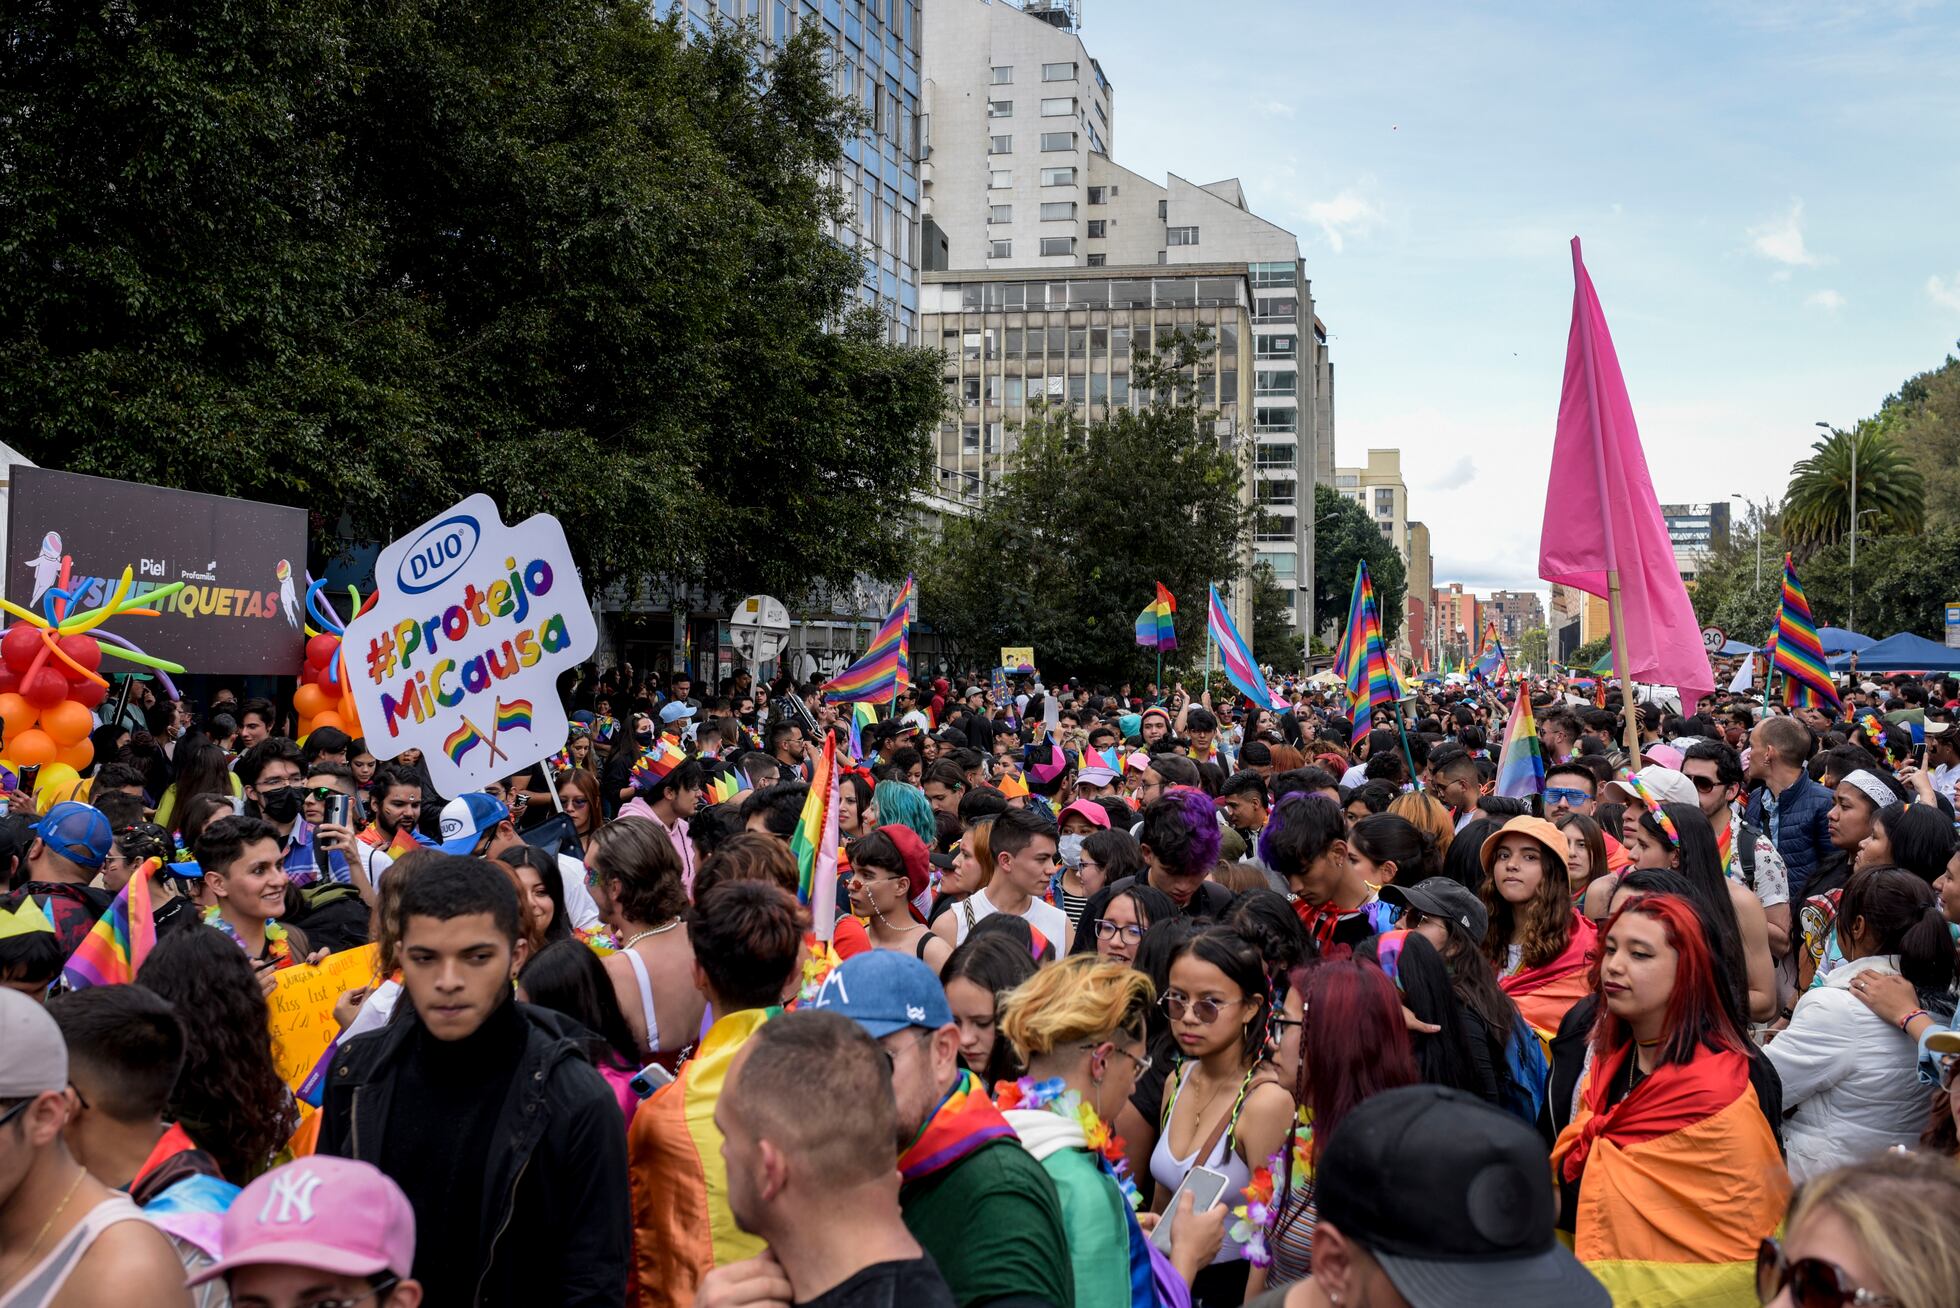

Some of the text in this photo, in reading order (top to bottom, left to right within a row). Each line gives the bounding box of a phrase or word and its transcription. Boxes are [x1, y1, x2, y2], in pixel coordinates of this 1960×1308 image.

[140, 558, 165, 577] Piel
[181, 570, 216, 582] Profamilia
[366, 556, 554, 685] #Protejo
[1703, 632, 1721, 646] 30
[380, 613, 572, 738] MiCausa
[257, 1167, 324, 1225] NY
